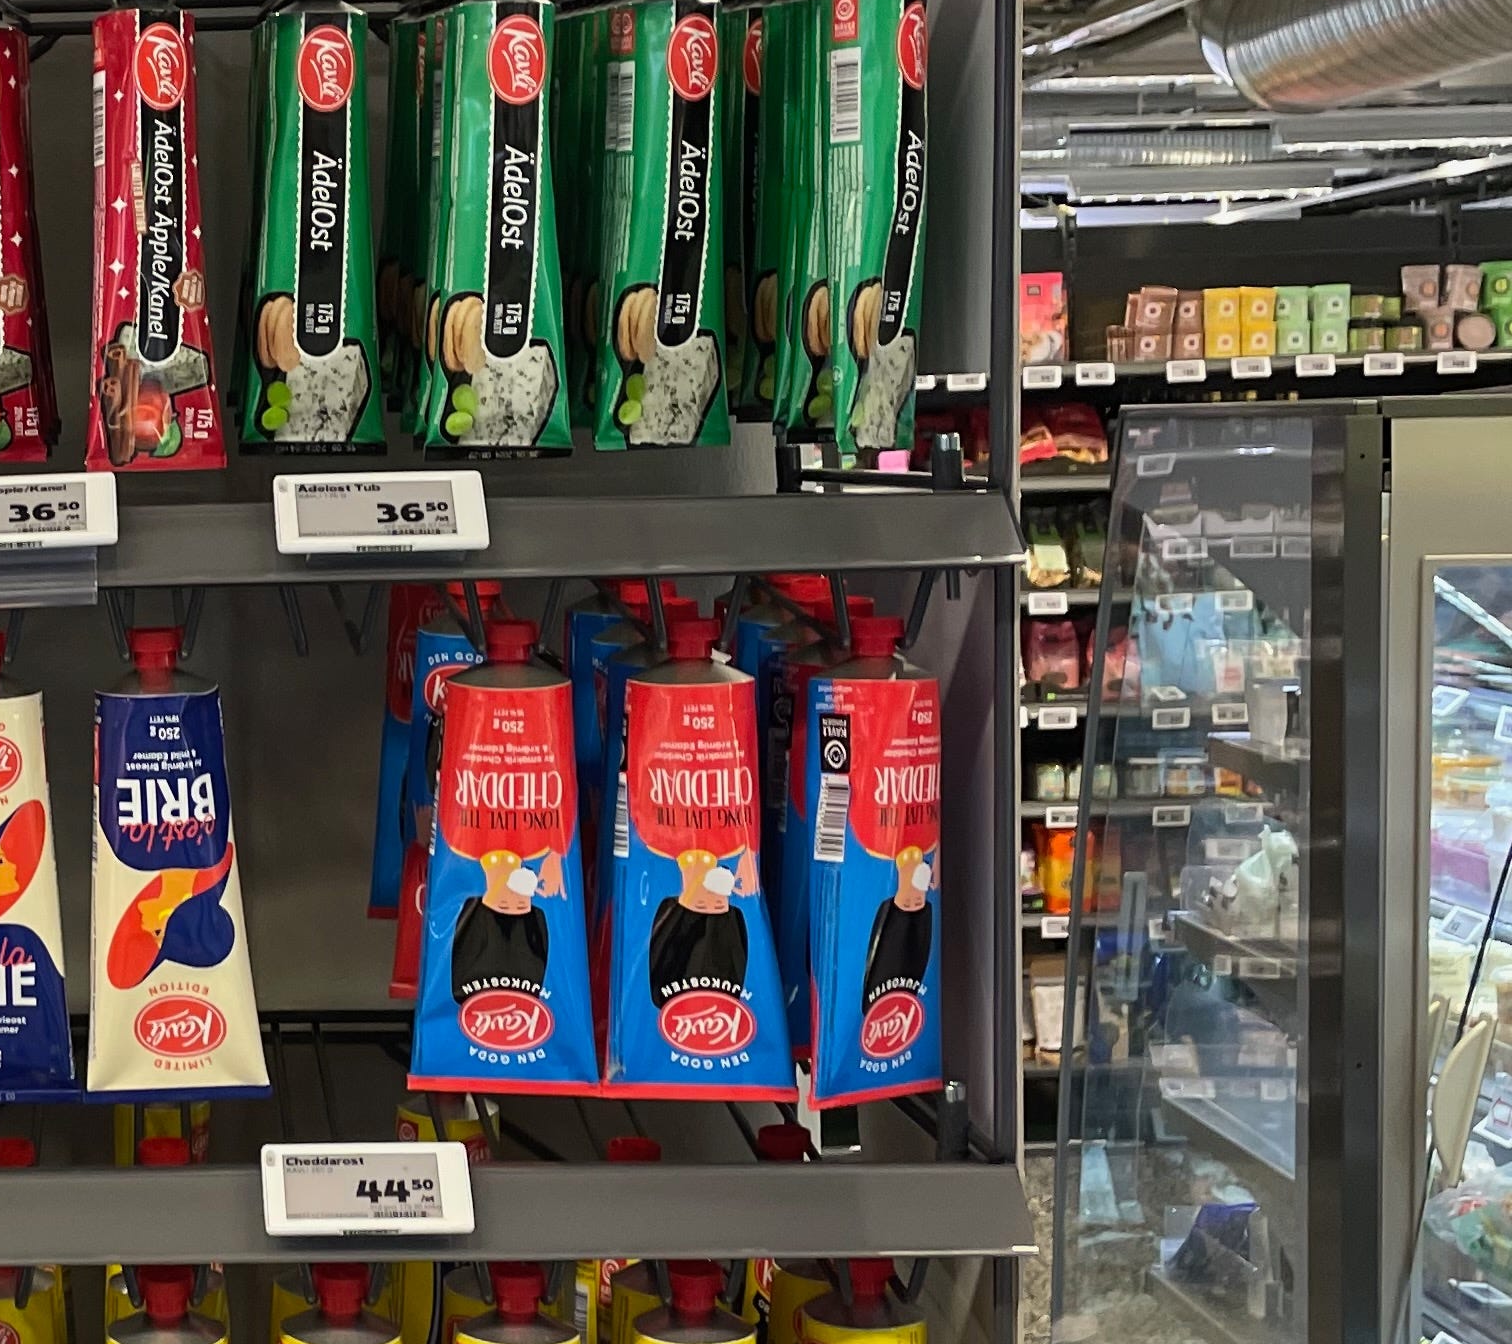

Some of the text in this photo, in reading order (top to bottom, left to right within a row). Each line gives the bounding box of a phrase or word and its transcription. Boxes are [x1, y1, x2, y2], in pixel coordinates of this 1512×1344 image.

[674, 138, 708, 241] ÄdelOst
[895, 129, 927, 236] ÄdelOst
[310, 150, 344, 252] ÄdelOst
[500, 144, 536, 251] ÄdelOst
[148, 118, 180, 341] ÄdelOst Äpple/Kanel
[354, 483, 381, 492] Tub
[8, 501, 80, 524] 36 50
[376, 501, 449, 524] 36 50
[157, 726, 181, 740] 250
[502, 719, 525, 733] 250
[691, 715, 715, 730] 250
[821, 725, 848, 738] KAVLI
[117, 773, 216, 827] BRIE
[455, 768, 563, 810] CHEDDAR
[647, 767, 753, 808] CHEDDAR
[522, 810, 560, 831] LONG
[716, 807, 754, 829] LONG
[129, 812, 215, 853] c'est la
[0, 936, 33, 967] la
[147, 982, 212, 997] EDITION
[461, 975, 552, 1001] MJUKOSTEN
[659, 975, 753, 1001] MJUKOSTEN
[868, 976, 927, 1003] MJUKOSTEN
[145, 1006, 216, 1052] Kavli
[471, 1002, 540, 1042] Kavli
[672, 1006, 741, 1046] Kavli
[153, 1056, 214, 1071] LIMITED
[468, 1045, 547, 1066] DEN GODA
[669, 1050, 750, 1071] DEN GODA
[859, 1049, 912, 1074] DEN GODA
[285, 1156, 364, 1166] Cheddarost
[356, 1178, 434, 1204] 44 50
